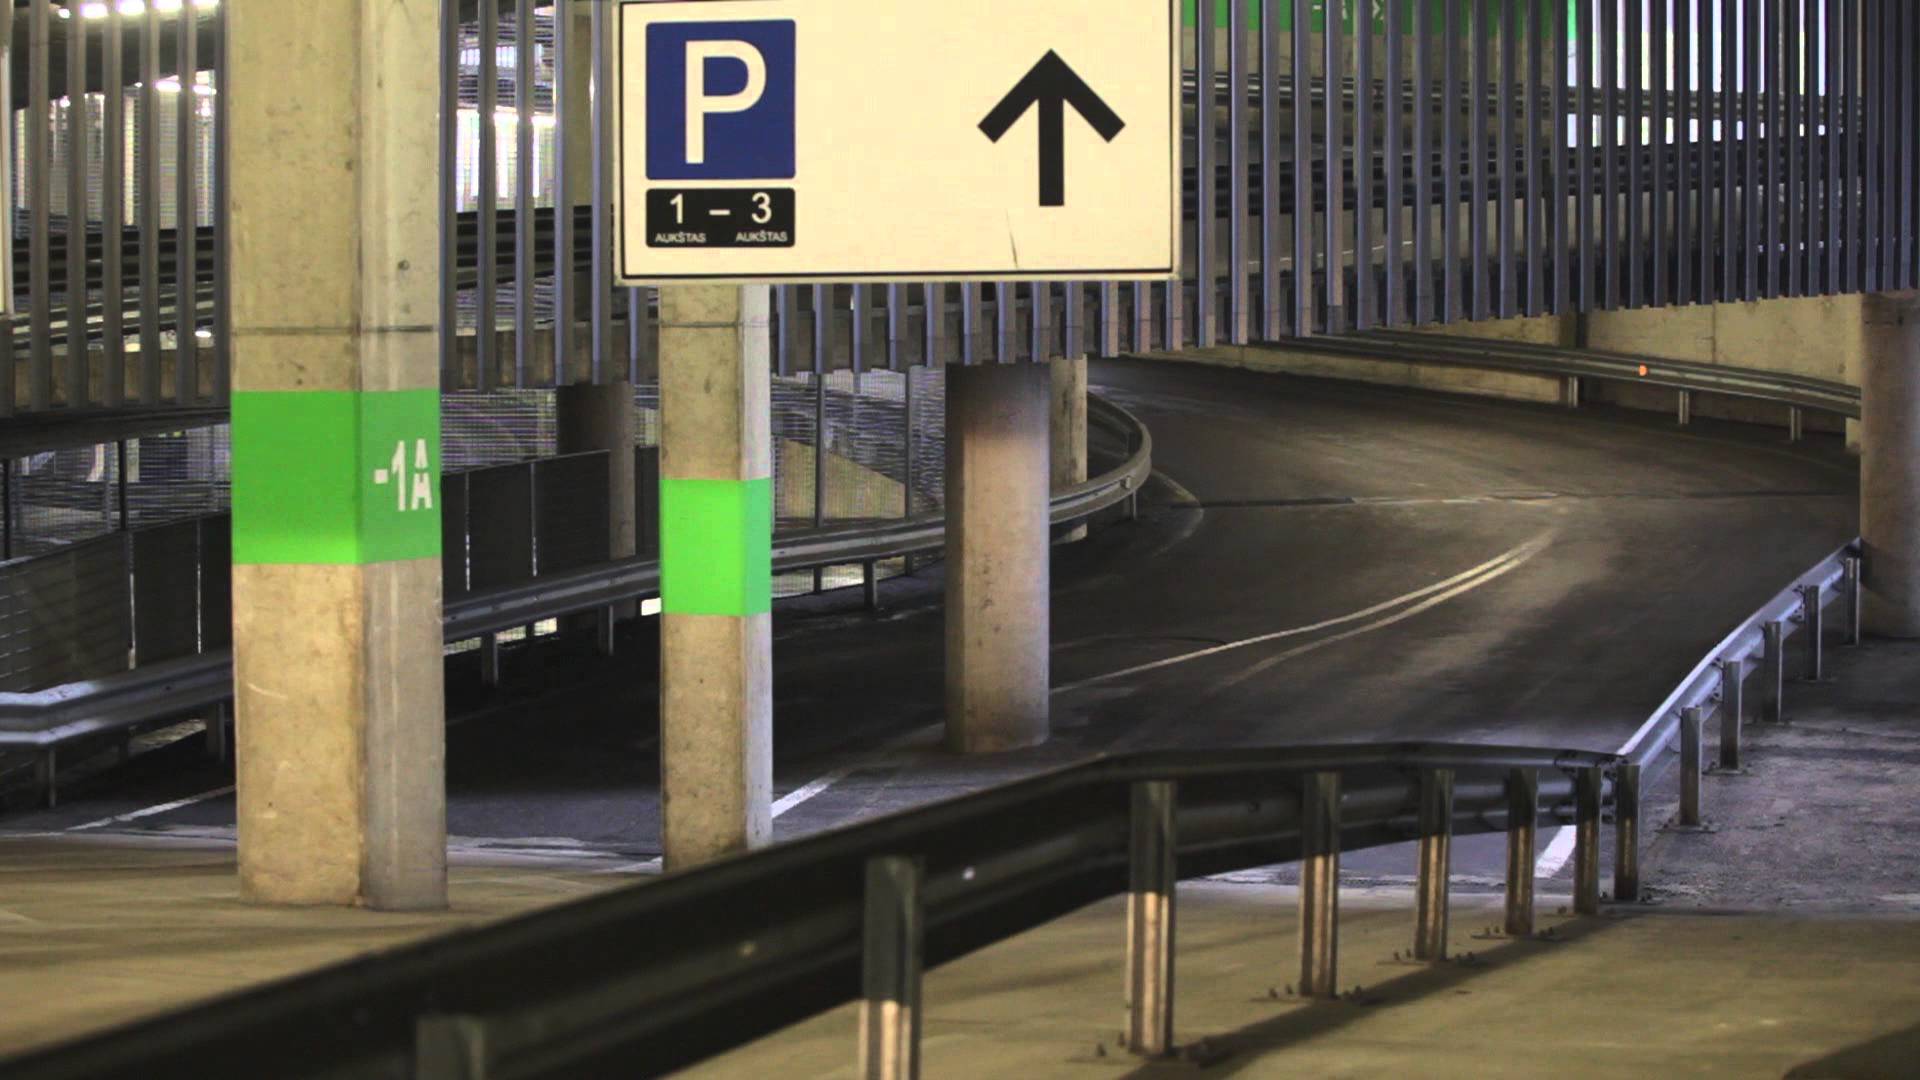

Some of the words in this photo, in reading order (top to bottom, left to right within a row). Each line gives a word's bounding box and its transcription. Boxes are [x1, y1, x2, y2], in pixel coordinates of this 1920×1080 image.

[685, 39, 767, 164] P
[670, 193, 683, 224] 1
[751, 192, 772, 224] 3
[655, 231, 707, 244] AUKŠTAS
[735, 230, 788, 243] AUKŠTAS
